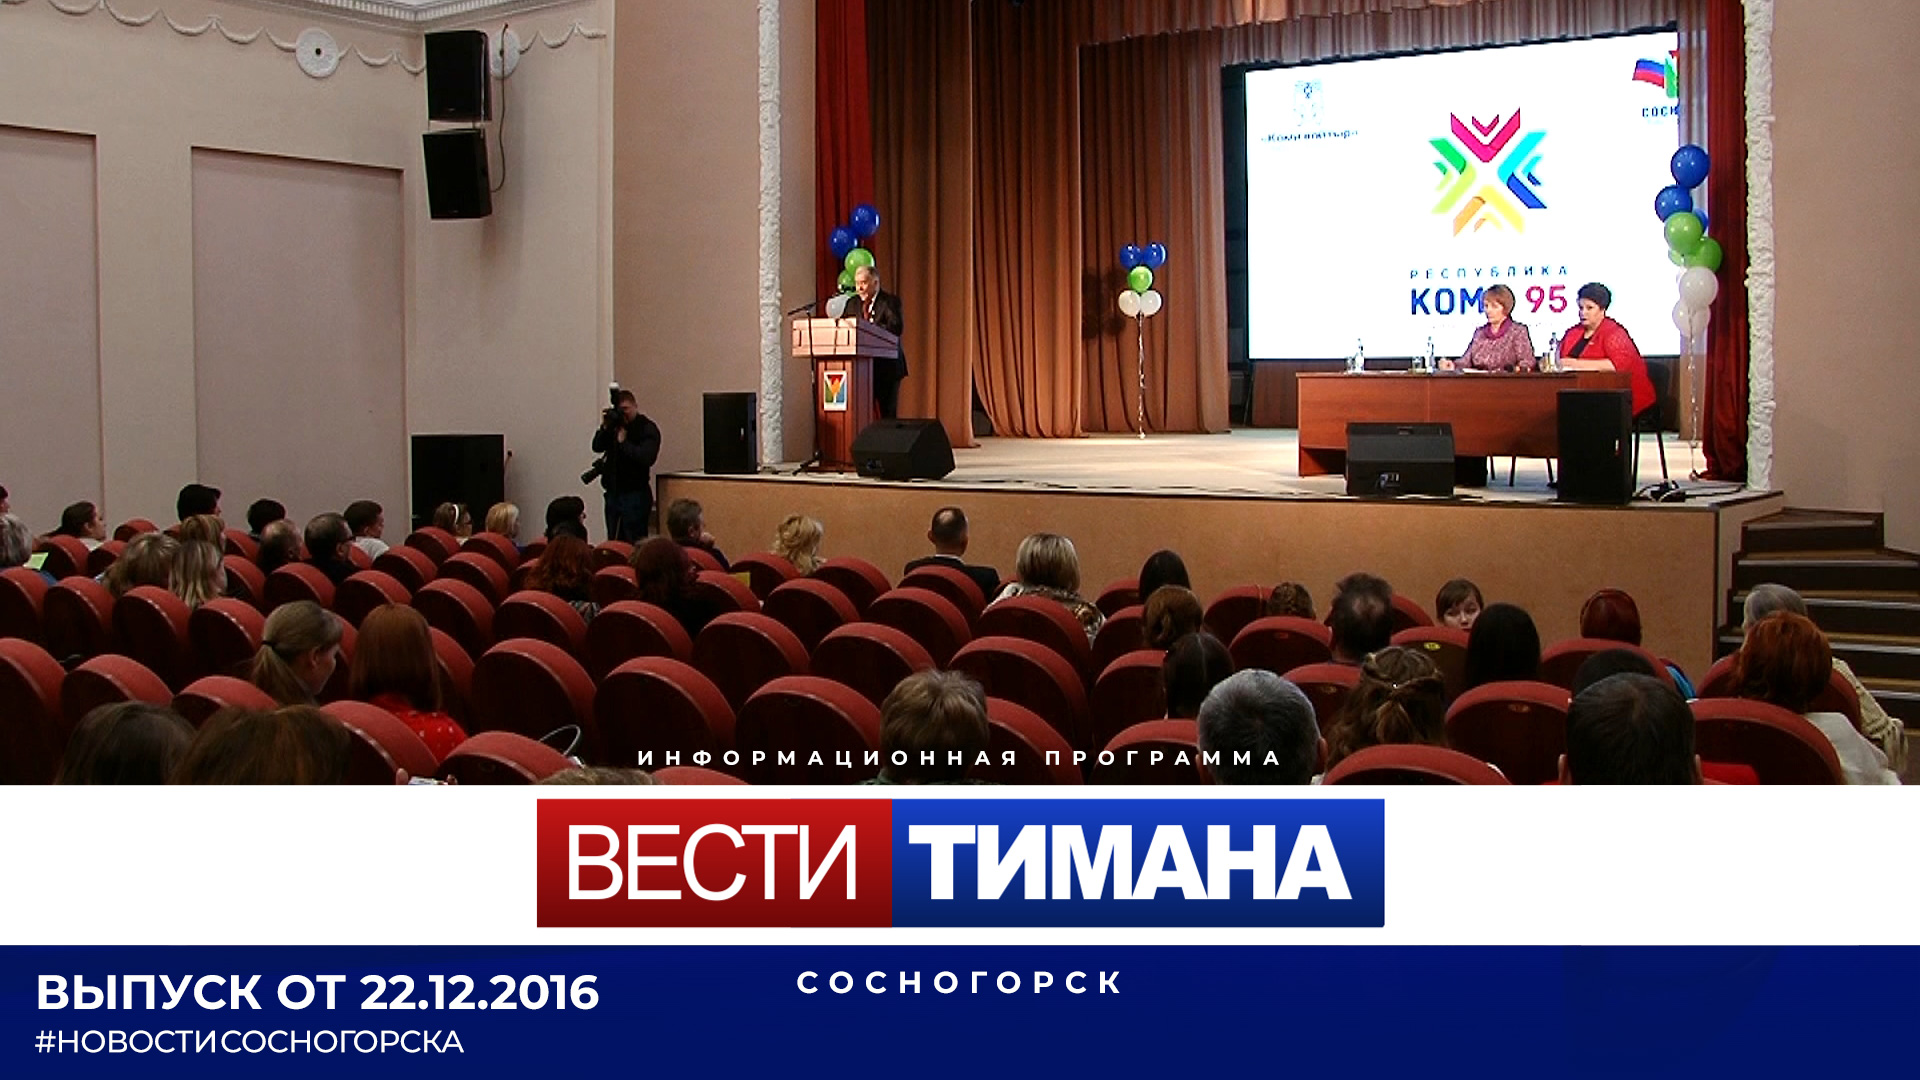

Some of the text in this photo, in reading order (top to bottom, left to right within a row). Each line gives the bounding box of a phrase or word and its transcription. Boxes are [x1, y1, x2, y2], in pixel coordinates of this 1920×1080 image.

[1410, 265, 1568, 279] РЕСПУБЛИКА
[1411, 284, 1568, 315] КОМ 95
